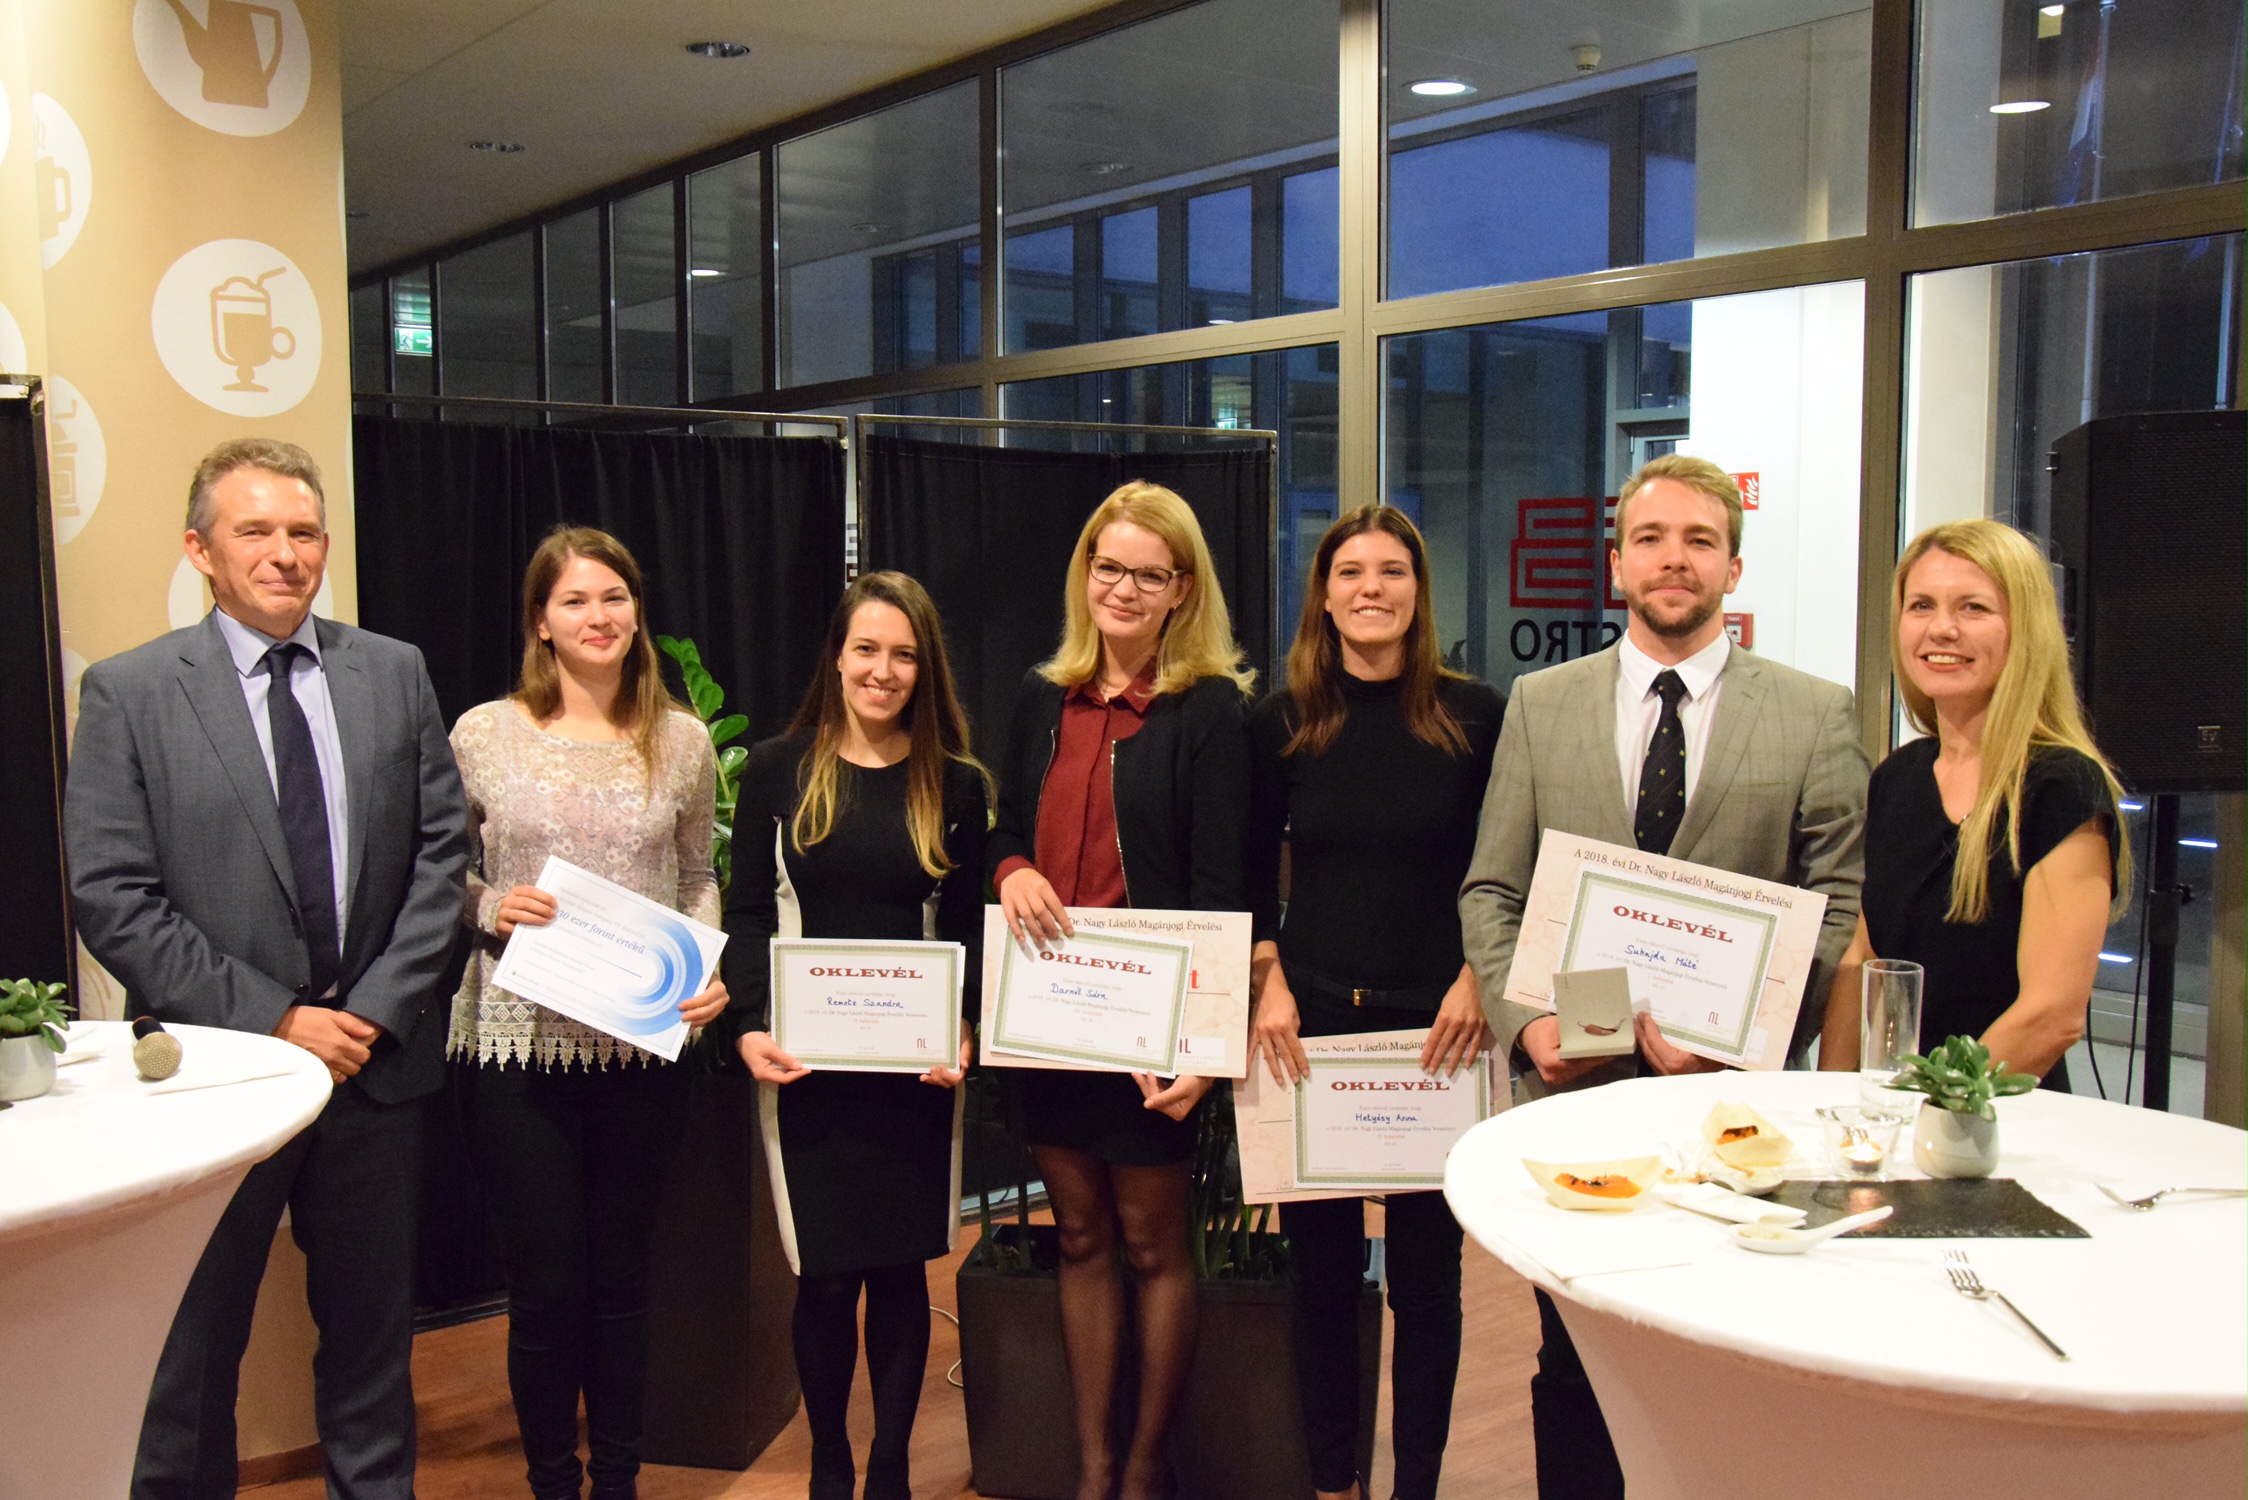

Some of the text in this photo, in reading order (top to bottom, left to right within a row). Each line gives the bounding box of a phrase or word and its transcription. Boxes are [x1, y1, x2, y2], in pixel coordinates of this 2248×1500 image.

[1574, 849, 1793, 909] A 2018. évi Dr. Nagy László Magánjogi Érvelési
[1084, 918, 1105, 928] Nagy
[1109, 918, 1136, 928] László
[1139, 920, 1184, 932] Magánjogi
[1187, 919, 1222, 931] Érvelési
[1613, 906, 1733, 943] OKLEVÉL
[570, 916, 589, 928] ezer
[589, 924, 615, 941] forint
[616, 936, 646, 954] értékű
[1040, 951, 1152, 975] OKLEVÉL
[1676, 957, 1699, 970] Máté
[810, 966, 923, 978] OKLEVÉL
[1086, 990, 1108, 1000] Sára
[863, 999, 904, 1008] Szandra
[1359, 1042, 1387, 1052] László
[1390, 1040, 1426, 1051] Magánj
[1331, 1079, 1450, 1091] OKLEVÉL
